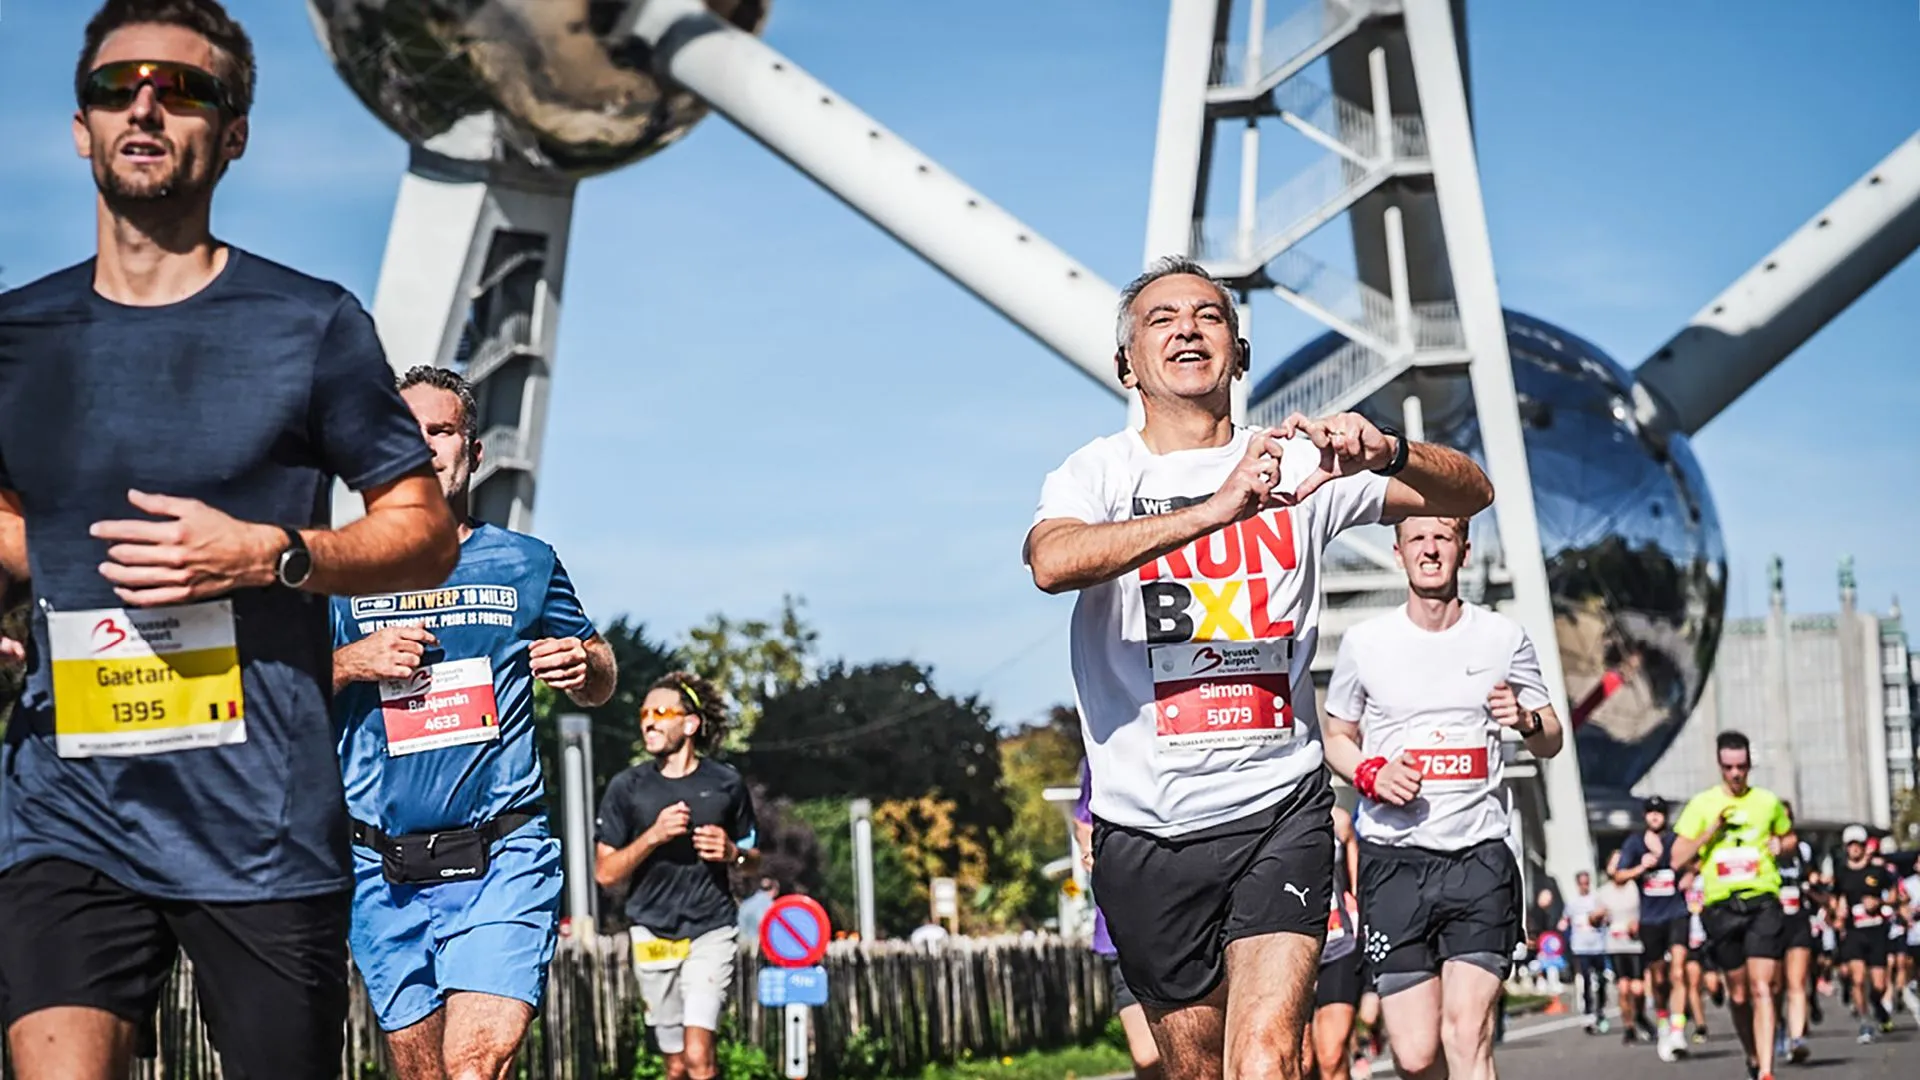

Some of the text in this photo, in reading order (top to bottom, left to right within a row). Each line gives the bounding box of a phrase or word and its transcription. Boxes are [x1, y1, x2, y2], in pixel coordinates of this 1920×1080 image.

[1141, 498, 1173, 515] WE
[400, 589, 459, 610] ANTWERP
[462, 588, 477, 604] 10
[479, 588, 514, 607] MILES
[467, 611, 477, 625] IS
[478, 611, 513, 627] FOREVER
[1141, 577, 1294, 644] BXL
[1222, 646, 1260, 658] brussels
[1224, 656, 1256, 667] airport
[1199, 683, 1253, 699] Simon
[112, 700, 165, 723] 1395
[408, 692, 470, 713] Benjamin
[424, 713, 460, 731] 4633
[1207, 707, 1253, 726] 5079
[1418, 754, 1472, 775] 7628
